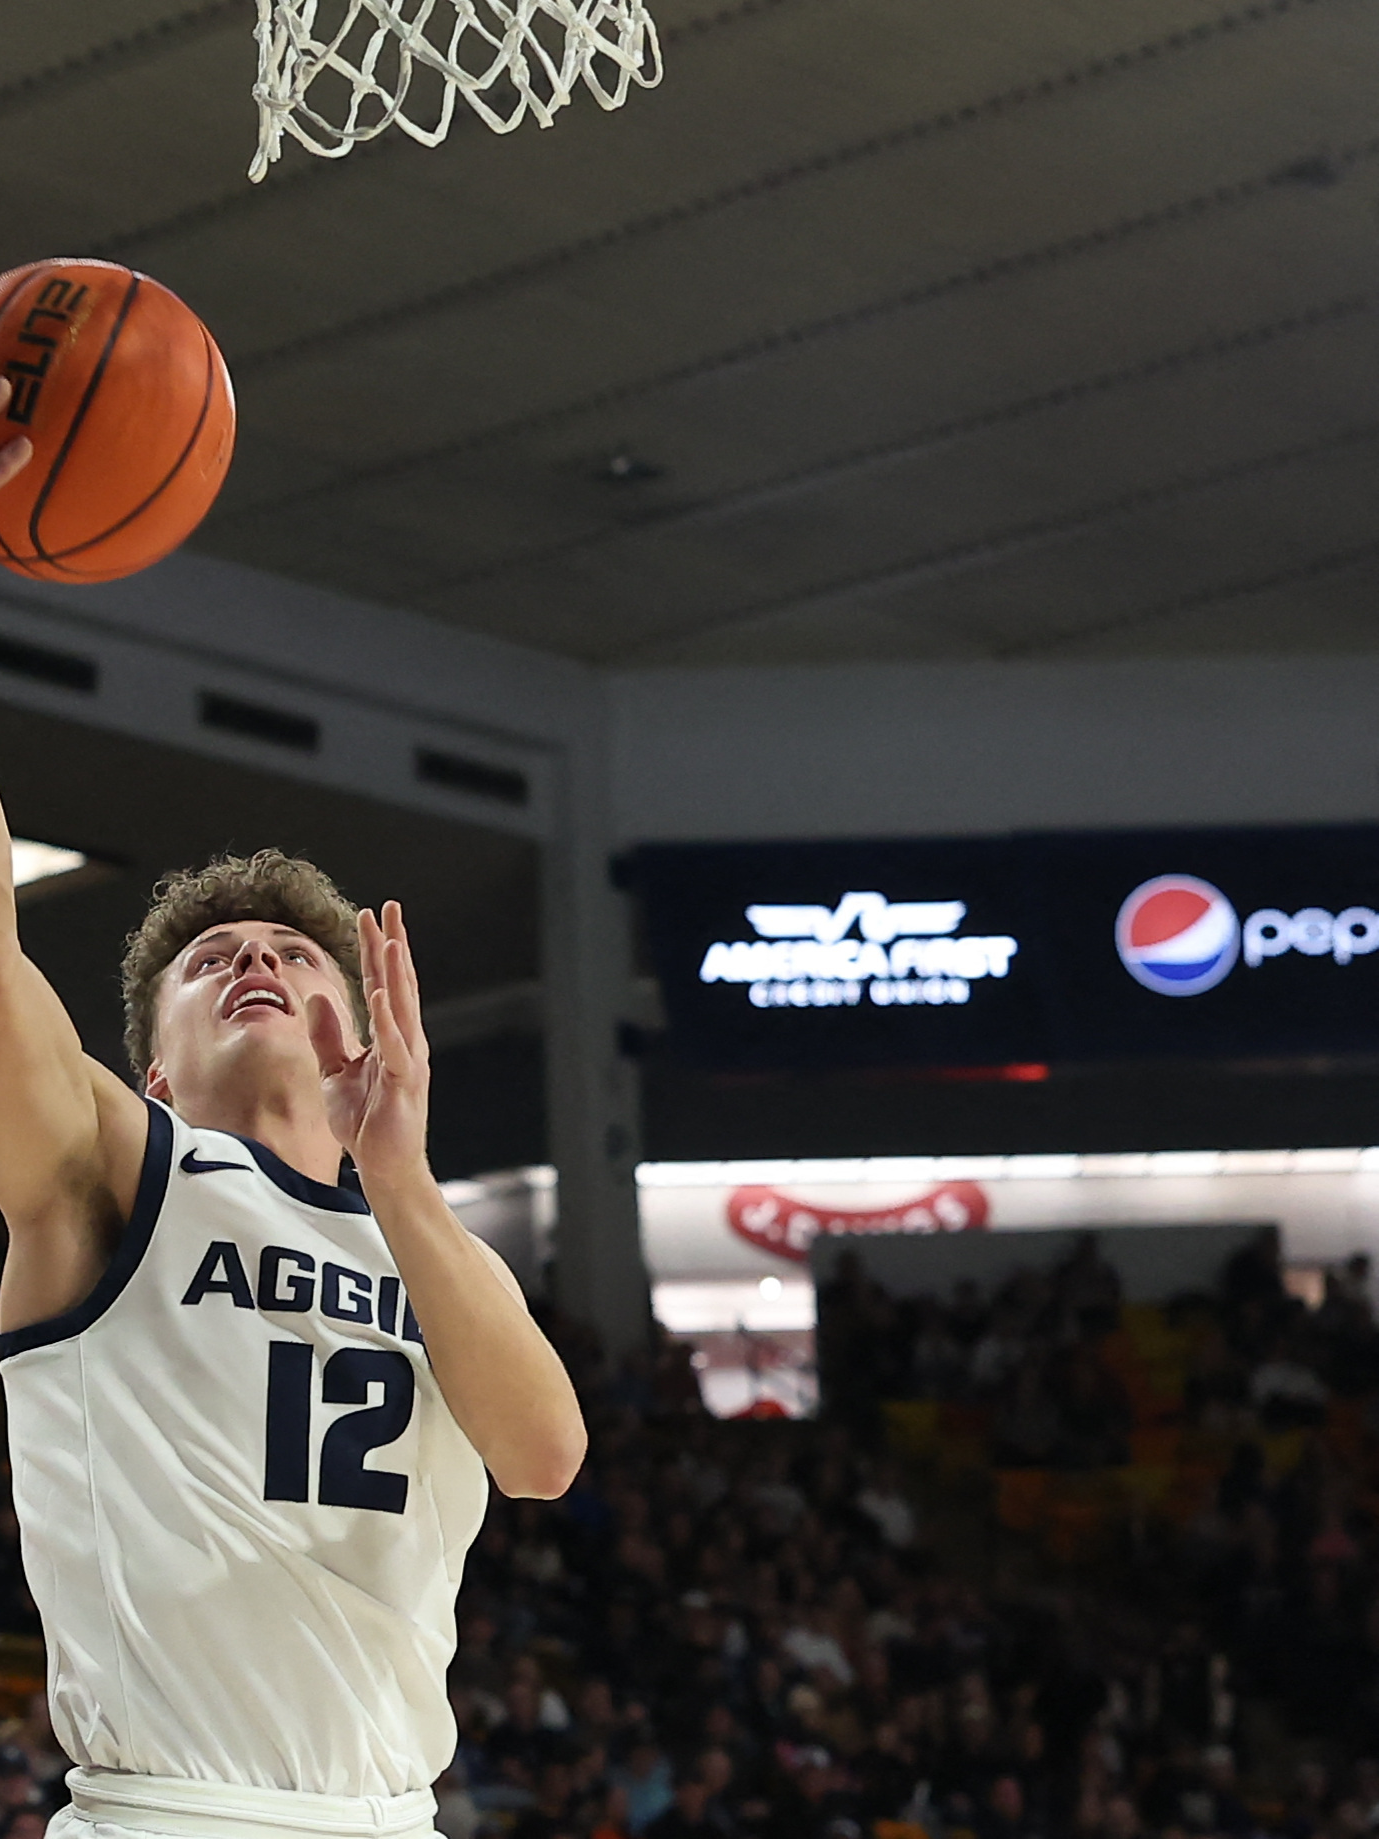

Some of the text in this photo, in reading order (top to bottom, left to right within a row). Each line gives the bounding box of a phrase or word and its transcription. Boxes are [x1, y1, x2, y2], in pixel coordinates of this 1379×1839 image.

[6, 278, 90, 425] ELITE
[1243, 906, 1379, 968] pep
[264, 1341, 416, 1515] 12
